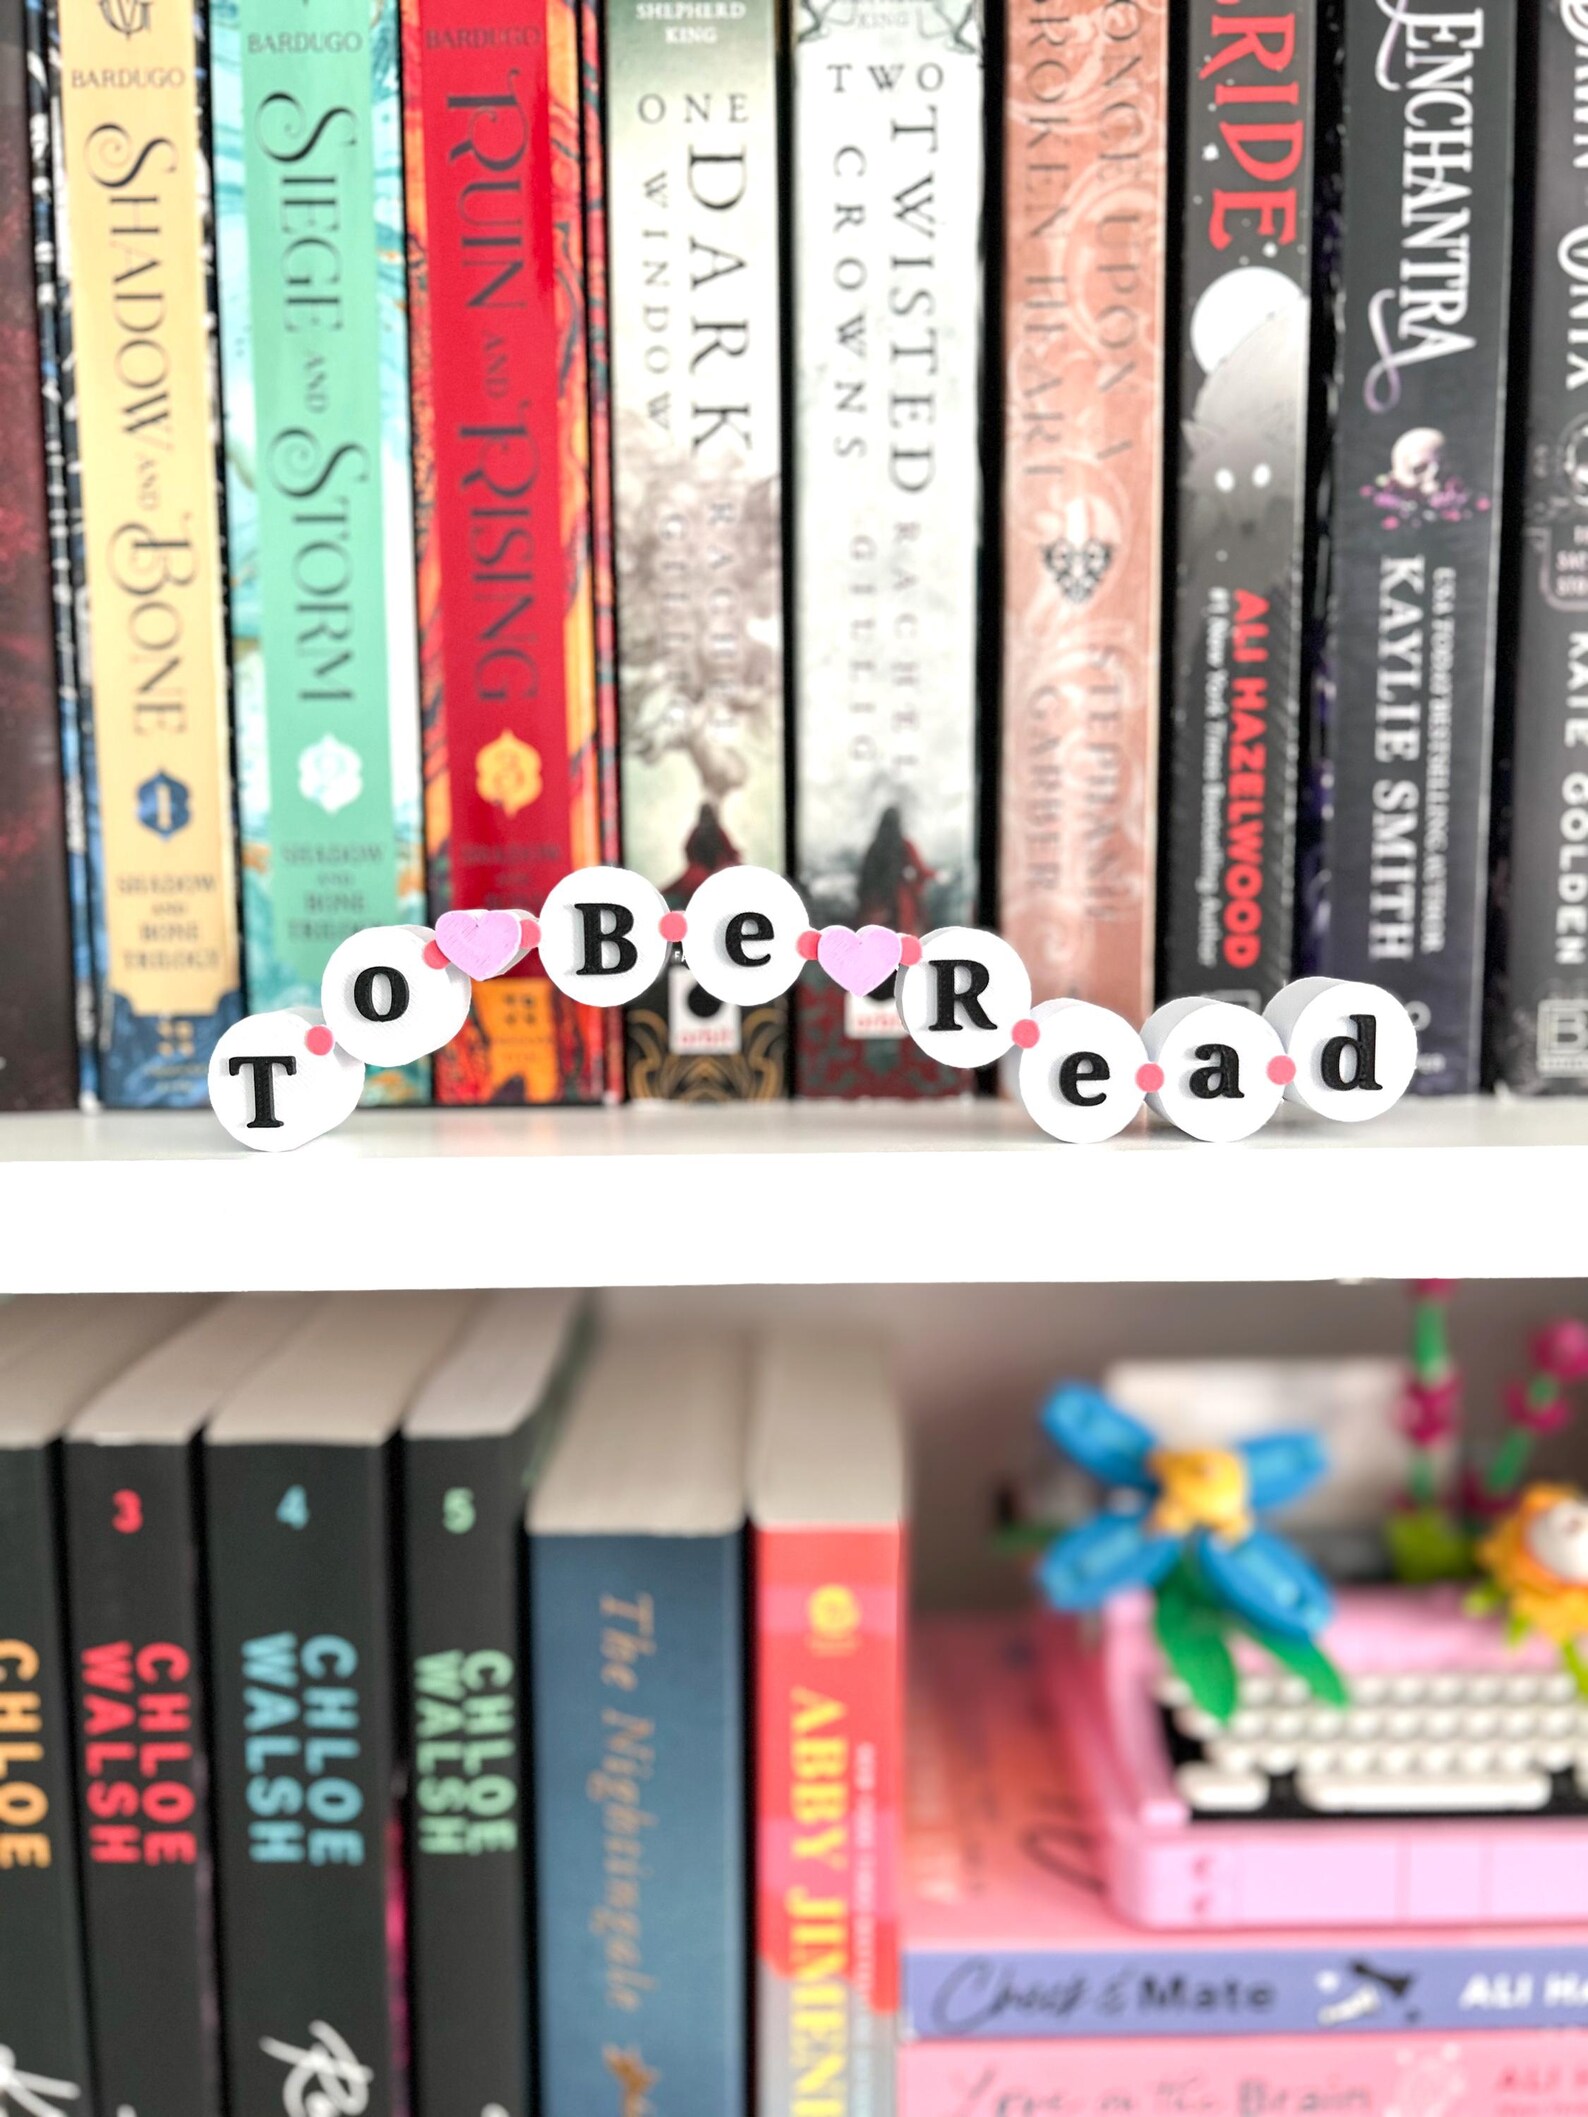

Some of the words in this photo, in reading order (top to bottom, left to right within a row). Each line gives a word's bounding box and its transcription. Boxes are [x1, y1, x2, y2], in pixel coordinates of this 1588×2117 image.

[71, 66, 185, 89] BARDUGO
[247, 31, 363, 53] BARDUGO
[425, 26, 542, 50] BARDUGO
[637, 92, 749, 125] ONE
[665, 26, 717, 44] KING
[827, 62, 945, 94] TWO
[1025, 0, 1071, 240] ROKEN
[1199, 0, 1304, 251] RIDE
[84, 121, 180, 453] SHADOW
[254, 92, 358, 334] SIEGE
[445, 67, 531, 311] RUIN
[1366, 0, 1485, 412] ENCHANTRA
[302, 346, 328, 415] AND
[481, 328, 510, 401] AND
[641, 168, 672, 431] WINDOW
[687, 143, 753, 451] DARK
[833, 144, 868, 459] CROWNS
[888, 104, 940, 494] TWISTED
[134, 452, 162, 513] AND
[266, 427, 371, 703] STORM
[457, 398, 541, 702] RISING
[105, 510, 200, 738] BONE
[1204, 668, 1229, 719] York
[1206, 615, 1231, 669] New
[1231, 587, 1270, 664] ALI
[1374, 554, 1426, 762] KAYLIE
[1222, 676, 1269, 970] HAZELWOOD
[1367, 778, 1420, 962] SMITH
[1555, 770, 1588, 965] GOLDEN
[229, 966, 410, 1130] To
[572, 902, 776, 977] Be
[926, 958, 1385, 1107] Read
[113, 1488, 144, 1535] 3
[276, 1484, 309, 1530] 4
[599, 1591, 658, 1692] The
[81, 1640, 142, 1863] WALSH
[135, 1641, 197, 1867] CHLOE
[241, 1630, 305, 1863] WALSH
[299, 1633, 366, 1867] CHLOE
[413, 1649, 472, 1855] WALSH
[458, 1649, 518, 1855] CHLOE
[790, 1686, 848, 1871] ABBY
[586, 1708, 659, 2012] Nightingale
[1136, 1971, 1280, 2016] Mate
[1457, 1971, 1535, 2011] ALI
